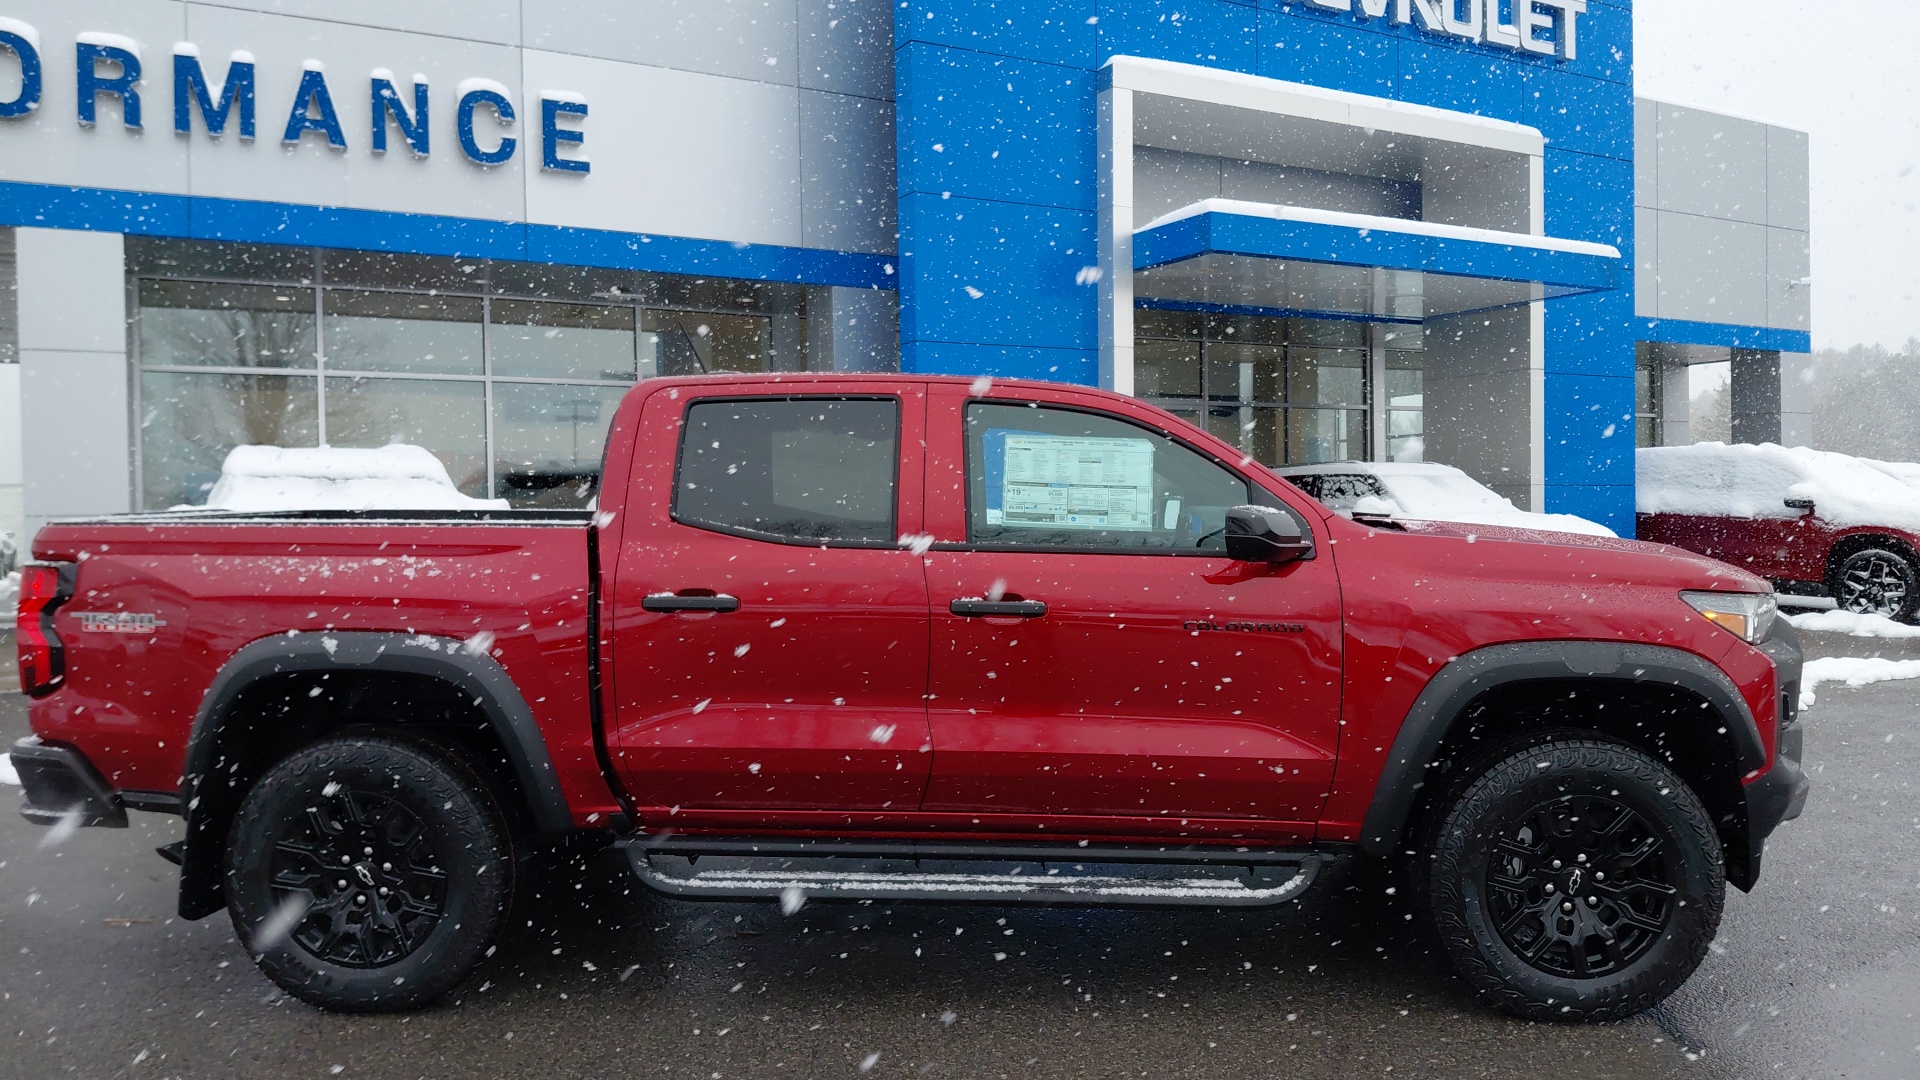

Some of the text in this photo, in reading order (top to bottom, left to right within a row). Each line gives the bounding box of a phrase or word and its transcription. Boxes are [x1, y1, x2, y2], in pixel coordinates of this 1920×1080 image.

[1305, 0, 1586, 60] ROLET
[1011, 488, 1021, 496] 19
[70, 611, 167, 626] TRAIL
[82, 623, 155, 633] BOSS
[1183, 620, 1304, 632] COLORADO
